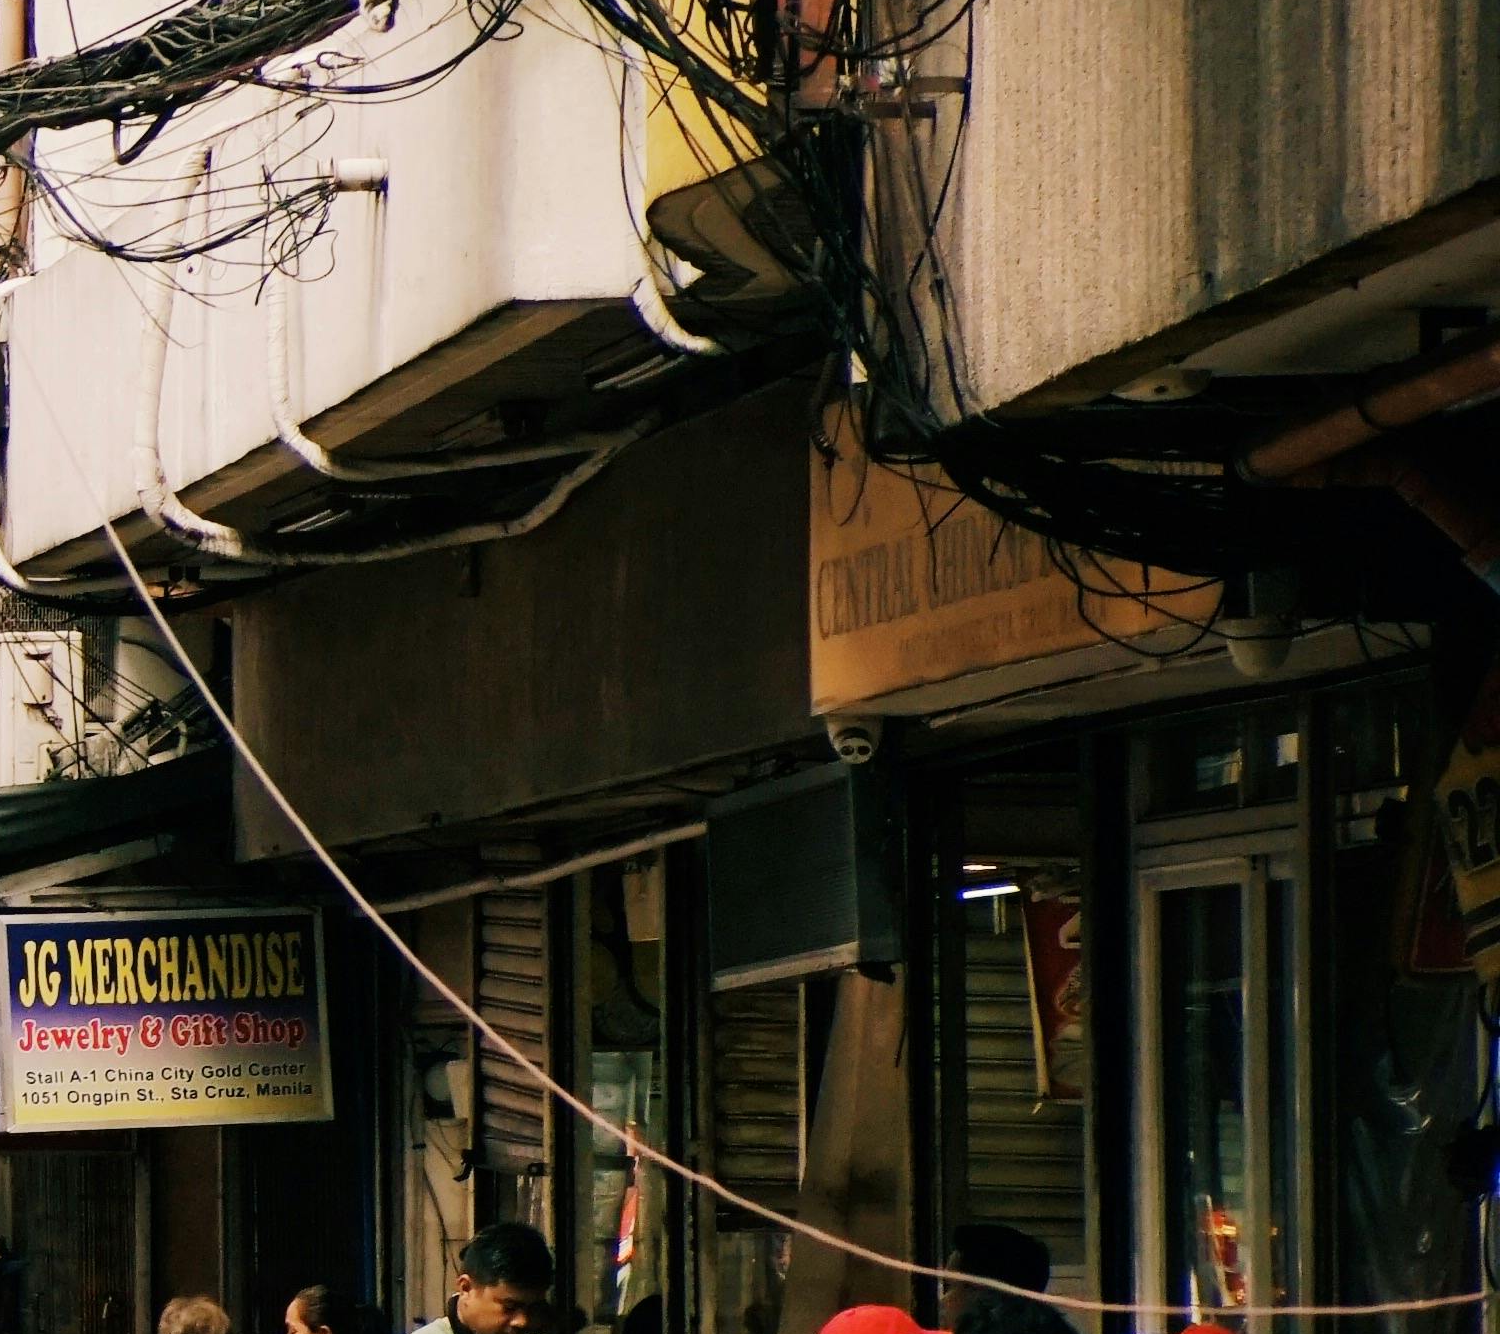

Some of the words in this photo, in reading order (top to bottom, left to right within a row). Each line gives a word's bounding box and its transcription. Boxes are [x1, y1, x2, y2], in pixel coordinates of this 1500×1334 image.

[19, 939, 62, 1008] JG
[67, 931, 305, 1006] MERCHANDISE
[17, 1019, 133, 1058] Jewelry
[140, 1015, 165, 1050] &
[170, 1013, 228, 1048] Gift
[233, 1012, 307, 1049] Shop
[26, 1071, 64, 1086] Stall
[70, 1069, 97, 1084] A-1
[104, 1067, 154, 1084] China
[161, 1066, 195, 1083] City
[201, 1063, 243, 1080] Gold
[248, 1062, 307, 1078] Center
[21, 1090, 59, 1106] 1051
[66, 1088, 131, 1108] Ongpin
[136, 1087, 166, 1105] St.,
[171, 1086, 199, 1102] Sta
[204, 1083, 251, 1101] Cruz,
[256, 1080, 314, 1098] Manila
